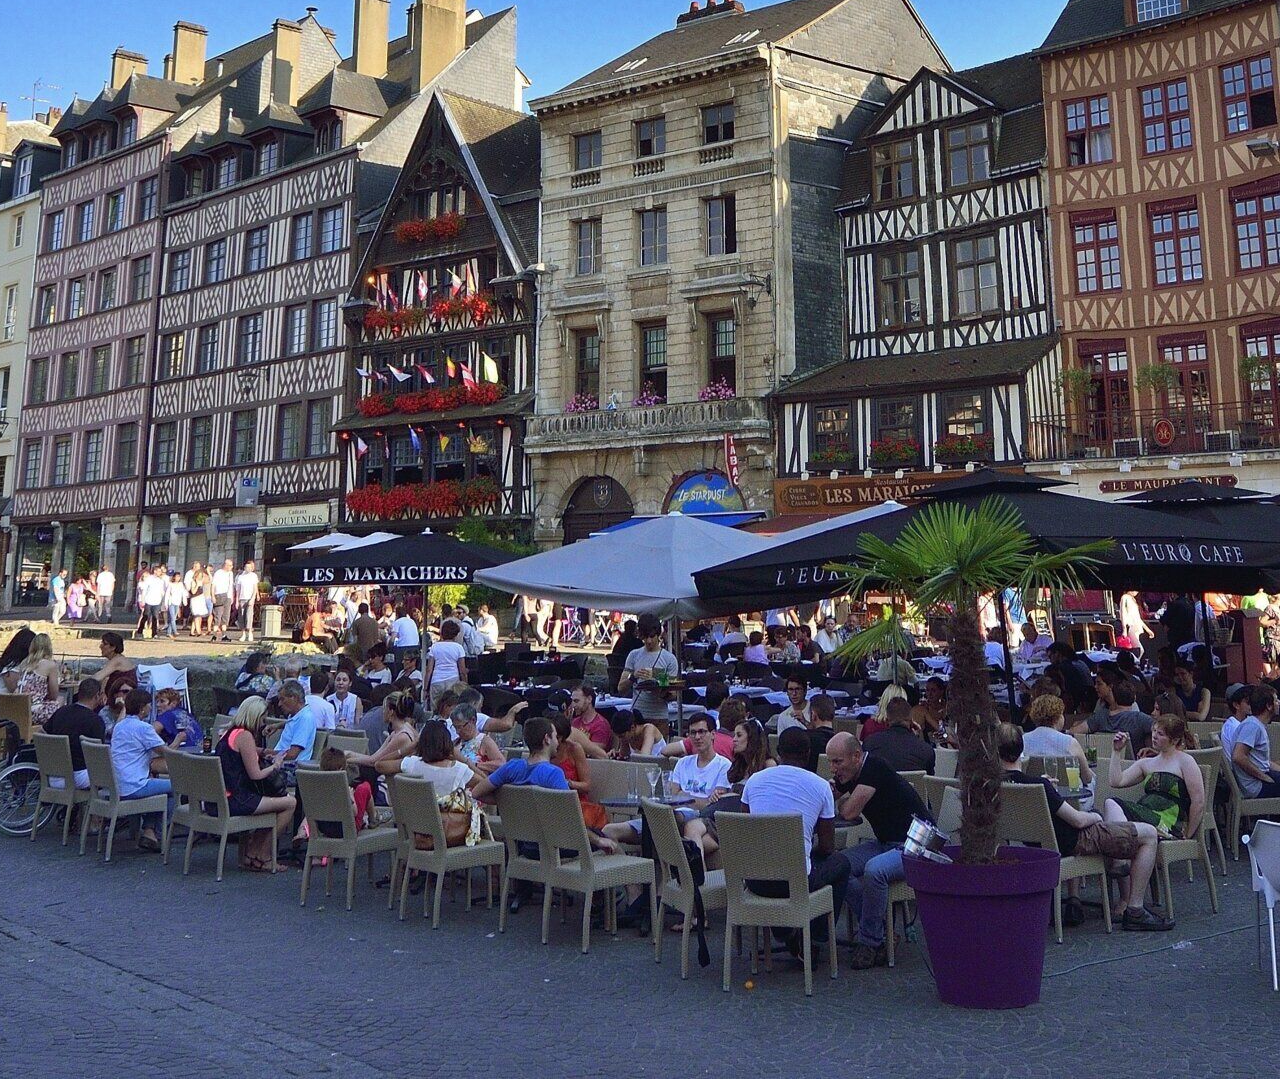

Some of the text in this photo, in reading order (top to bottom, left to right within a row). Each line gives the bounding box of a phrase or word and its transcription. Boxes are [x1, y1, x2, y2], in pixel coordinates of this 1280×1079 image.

[728, 435, 739, 486] TABAC
[874, 478, 911, 486] Restaurant
[1113, 481, 1127, 491] LE
[678, 488, 727, 502] LE STARDUST
[825, 488, 853, 504] LES
[273, 515, 323, 526] SOUVENIRS
[1199, 544, 1244, 563] CAFE
[303, 565, 468, 583] LES MARAICHERS
